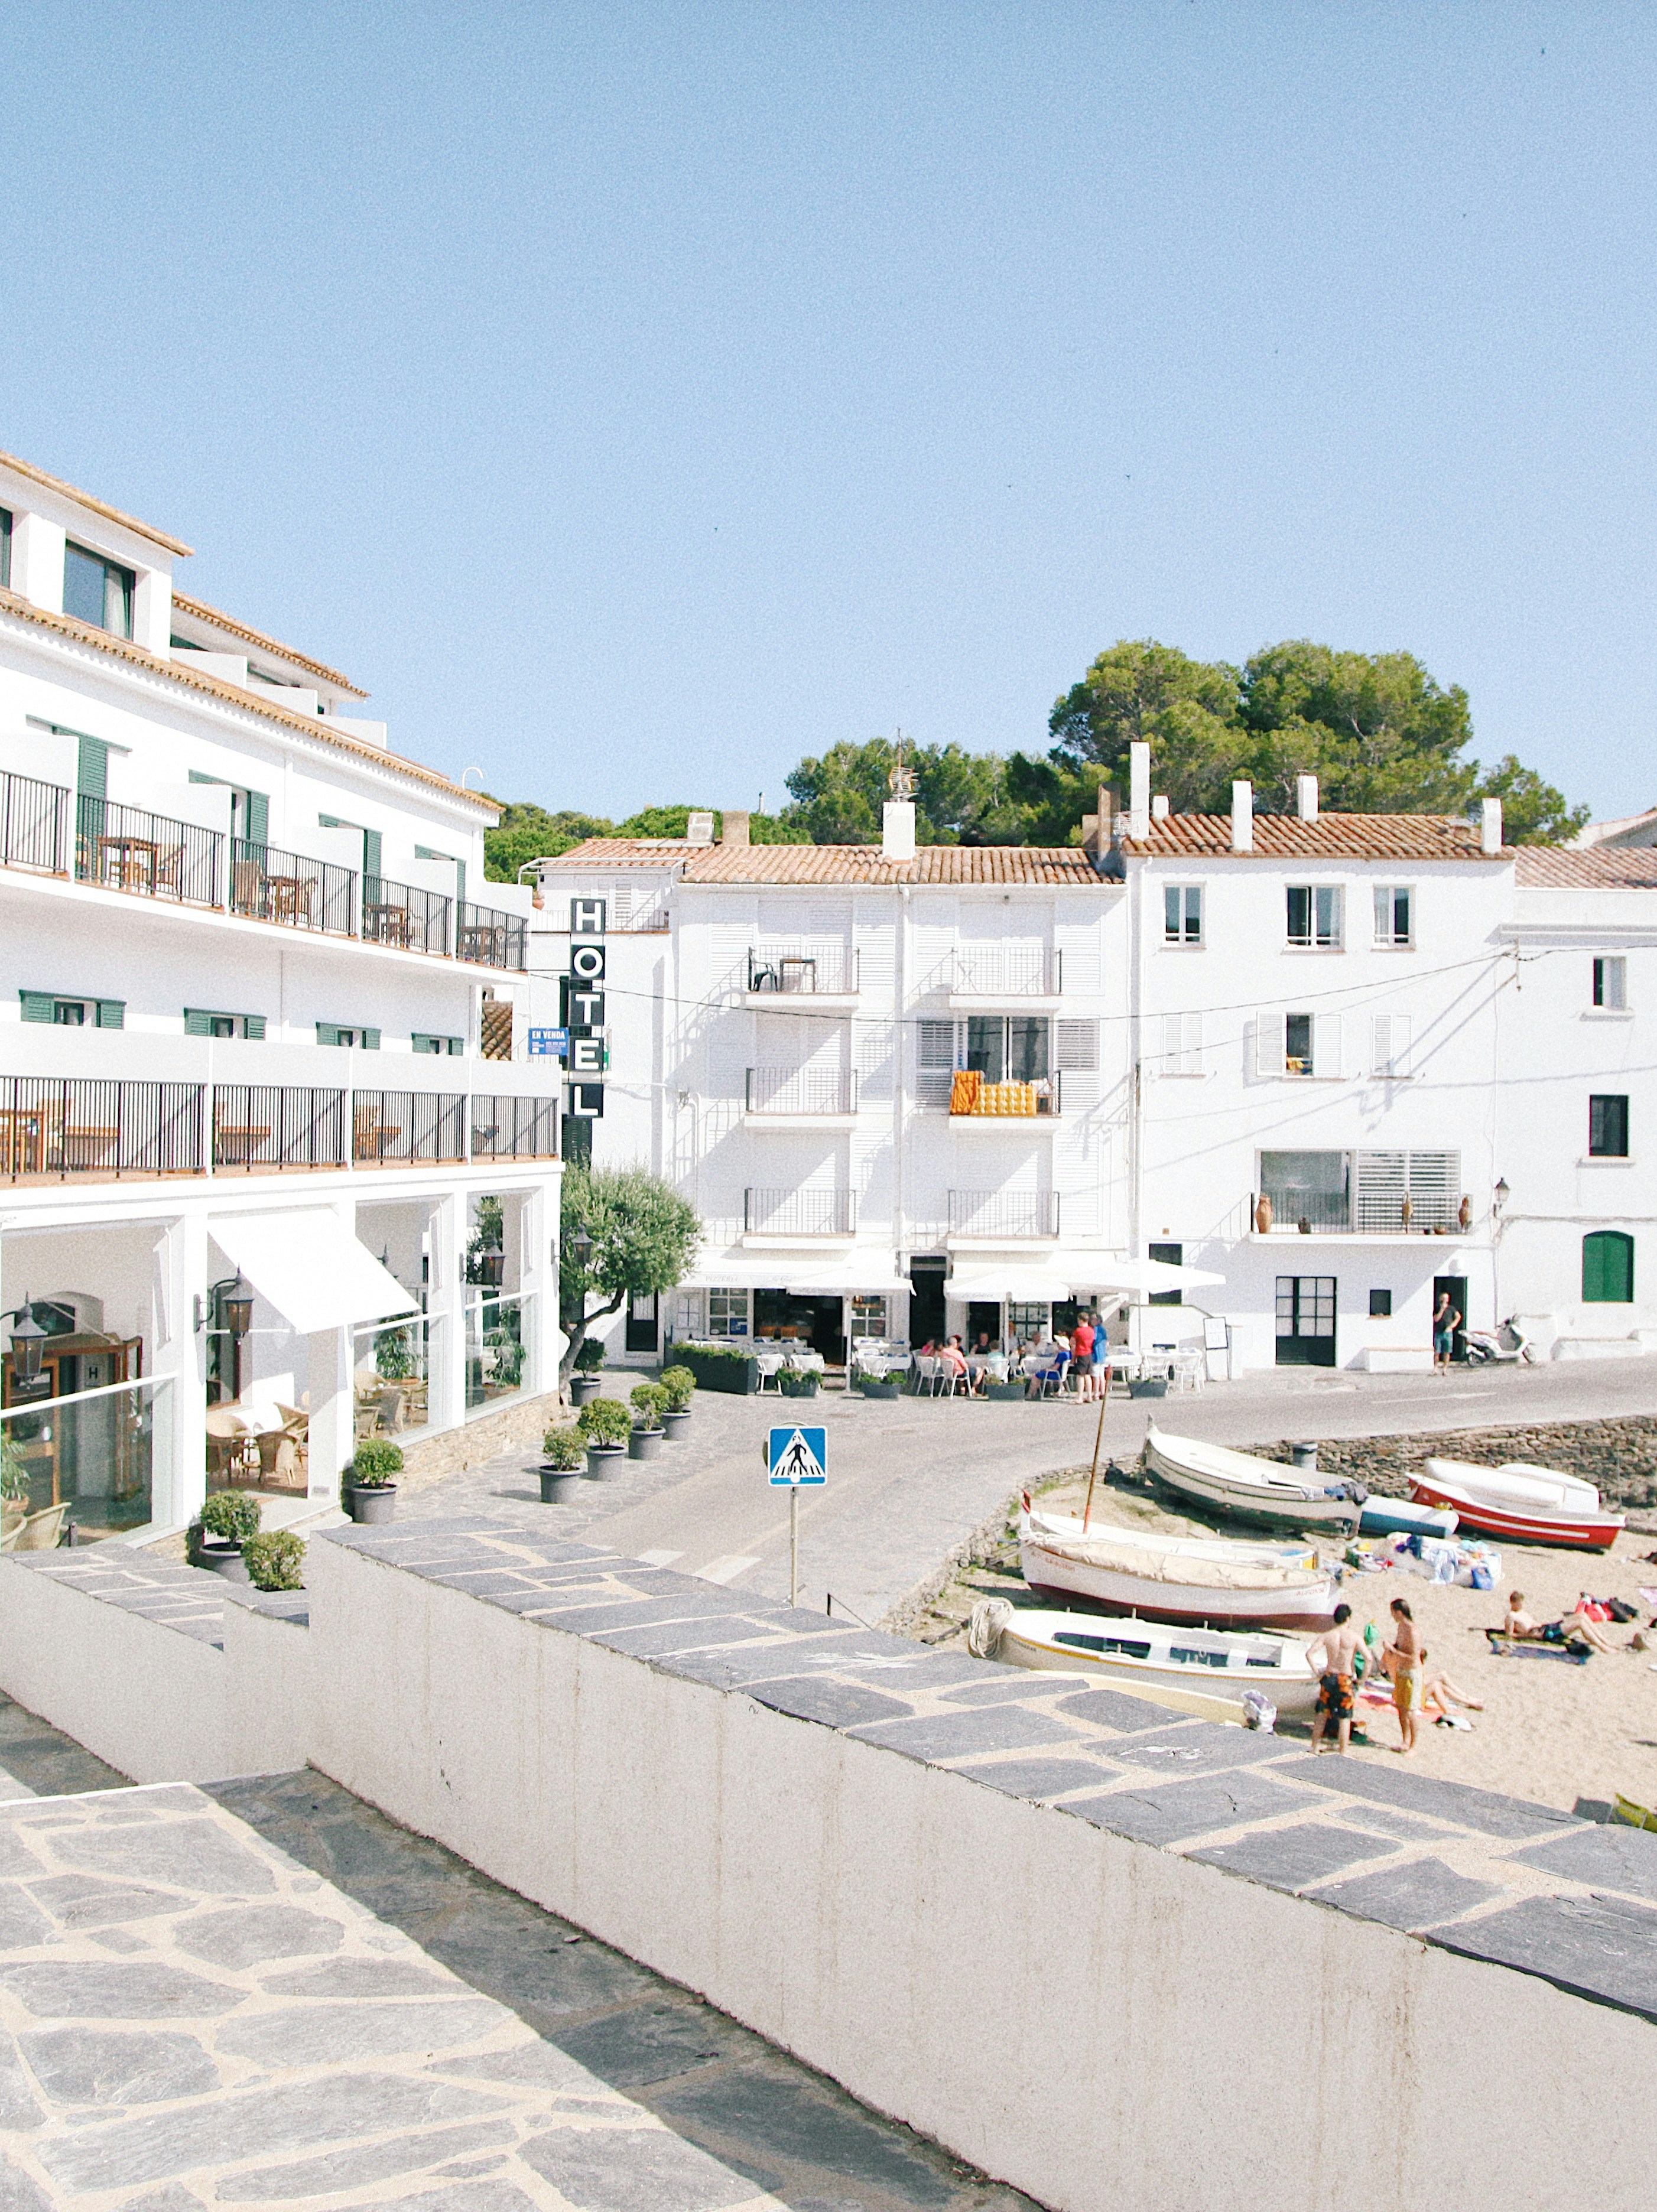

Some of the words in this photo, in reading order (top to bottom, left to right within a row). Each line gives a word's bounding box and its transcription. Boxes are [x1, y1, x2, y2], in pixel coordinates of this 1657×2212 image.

[532, 1030, 541, 1039] EN
[543, 1030, 566, 1039] VENDA
[573, 901, 603, 1116] HOTEL
